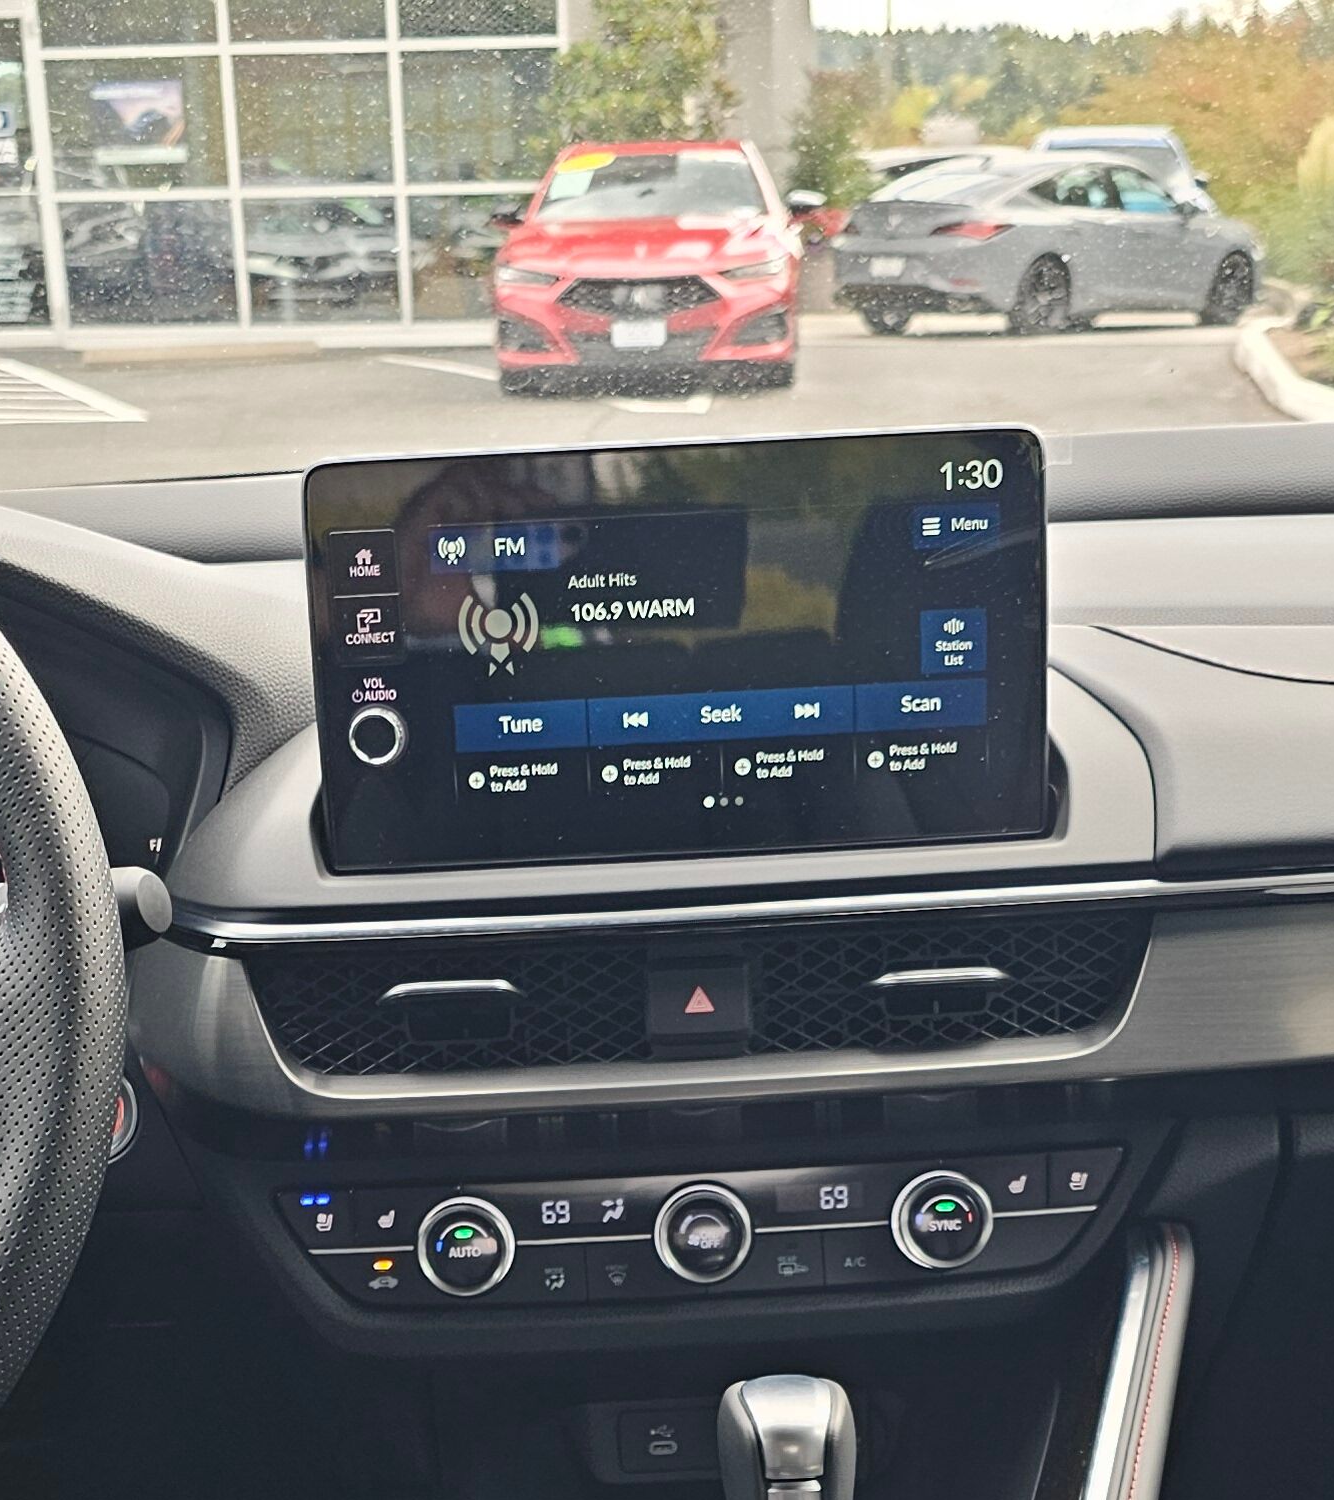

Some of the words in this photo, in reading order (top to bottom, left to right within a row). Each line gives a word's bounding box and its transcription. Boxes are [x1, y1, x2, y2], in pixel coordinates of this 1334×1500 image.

[939, 459, 1004, 491] 1:30
[950, 517, 989, 532] Menu
[494, 536, 526, 557] FM
[349, 564, 381, 578] HOME
[567, 573, 606, 590] Adult
[608, 572, 638, 588] Hits
[570, 601, 624, 622] 106.9
[626, 597, 696, 620] WARM
[345, 631, 396, 645] CONNECT
[935, 639, 973, 653] Station
[944, 654, 965, 667] List
[363, 677, 386, 690] VOL
[364, 688, 397, 702] AUDIO
[900, 694, 942, 714] Scan
[700, 704, 742, 724] Seek
[498, 715, 543, 734] Tune
[889, 743, 919, 757] Press
[920, 742, 930, 755] &
[931, 740, 958, 755] Hold
[622, 758, 652, 772] Press
[653, 757, 663, 770] &
[664, 755, 691, 770] Hold
[756, 751, 786, 765] Press
[787, 750, 797, 763] &
[798, 748, 825, 763] Hold
[489, 765, 519, 779] Press
[520, 764, 530, 777] &
[531, 762, 558, 777] Hold
[889, 760, 902, 771] to
[903, 758, 926, 771] Add
[622, 775, 635, 786] to
[636, 773, 659, 786] Add
[756, 768, 769, 779] to
[770, 766, 793, 779] Add
[489, 782, 502, 793] to
[503, 780, 526, 793] Add
[820, 1186, 848, 1210] 69
[541, 1200, 570, 1225] 69
[928, 1219, 962, 1232] SYNC
[448, 1246, 482, 1258] AUTO
[844, 1256, 867, 1268] A/C
